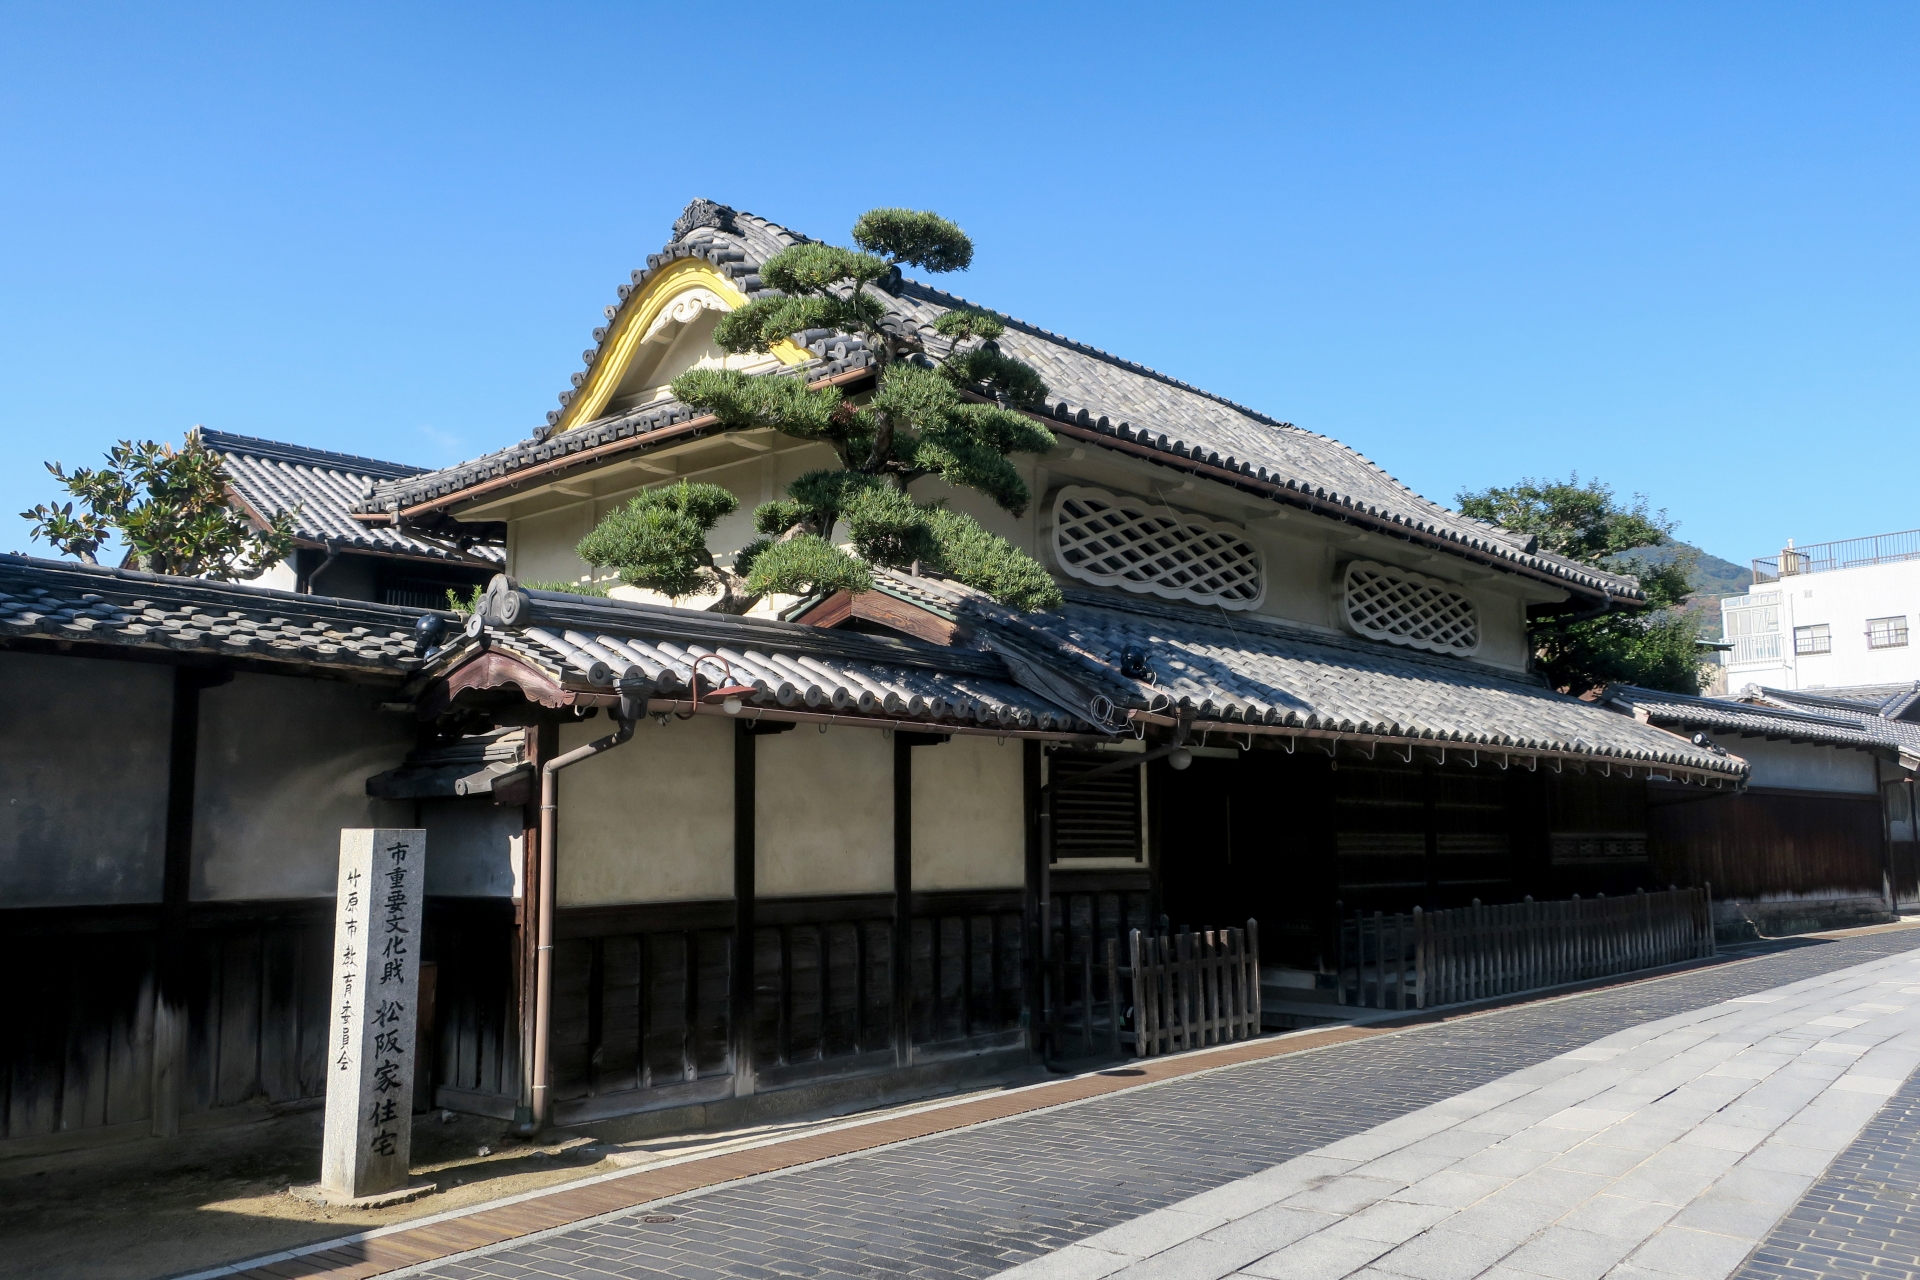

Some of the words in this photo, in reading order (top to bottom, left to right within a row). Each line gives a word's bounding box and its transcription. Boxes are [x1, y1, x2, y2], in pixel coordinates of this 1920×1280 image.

[336, 867, 362, 1071] 竹原市教育委員会
[380, 842, 410, 984] 市重要文化財
[368, 999, 405, 1157] 松阪家住宅
